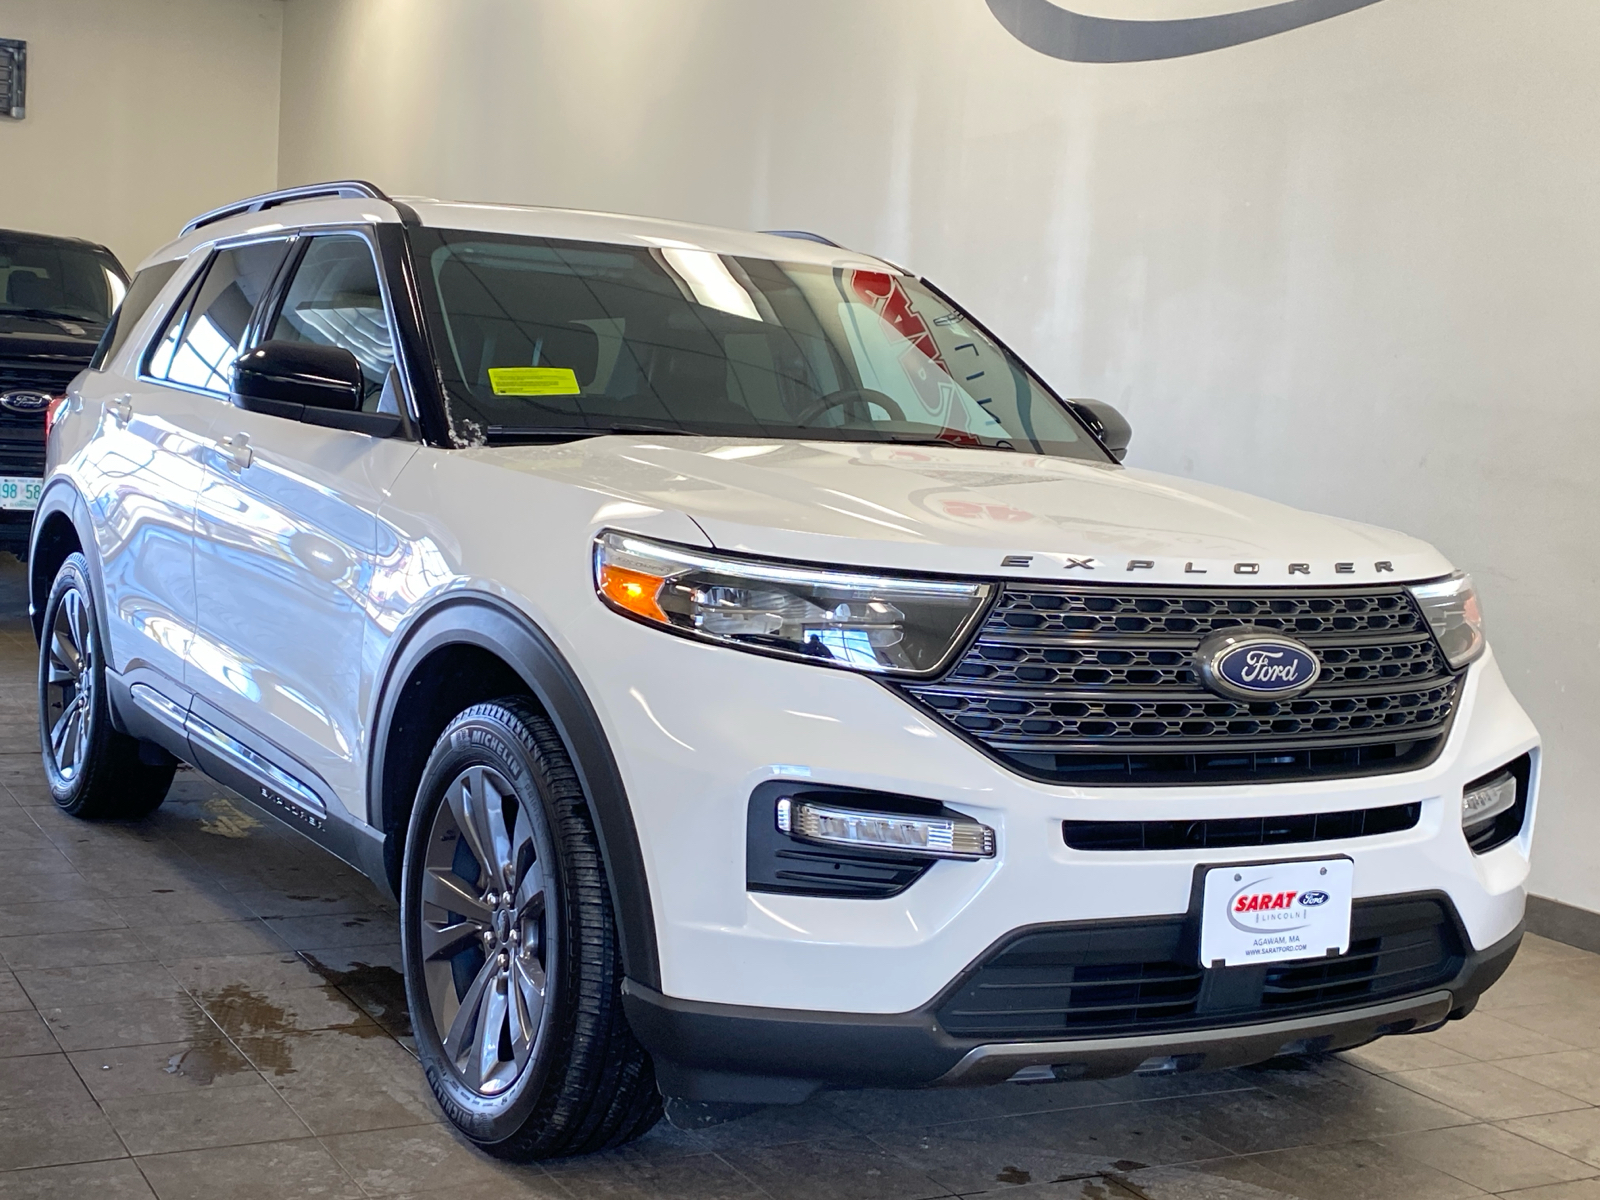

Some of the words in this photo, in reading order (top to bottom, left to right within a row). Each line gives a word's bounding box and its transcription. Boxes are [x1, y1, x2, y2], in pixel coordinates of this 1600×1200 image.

[0, 483, 18, 499] 98
[1000, 554, 1395, 575] EXPLORER
[1241, 650, 1299, 682] Ford
[471, 730, 521, 778] MICHELIN
[1234, 890, 1298, 913] SARAT
[1303, 892, 1324, 904] Ford
[1262, 912, 1300, 921] LINCOLN
[1245, 944, 1307, 955] WWW.SARATFORD.COM
[1253, 937, 1287, 946] AGAWAM,
[427, 1070, 473, 1129] MICHELIN
